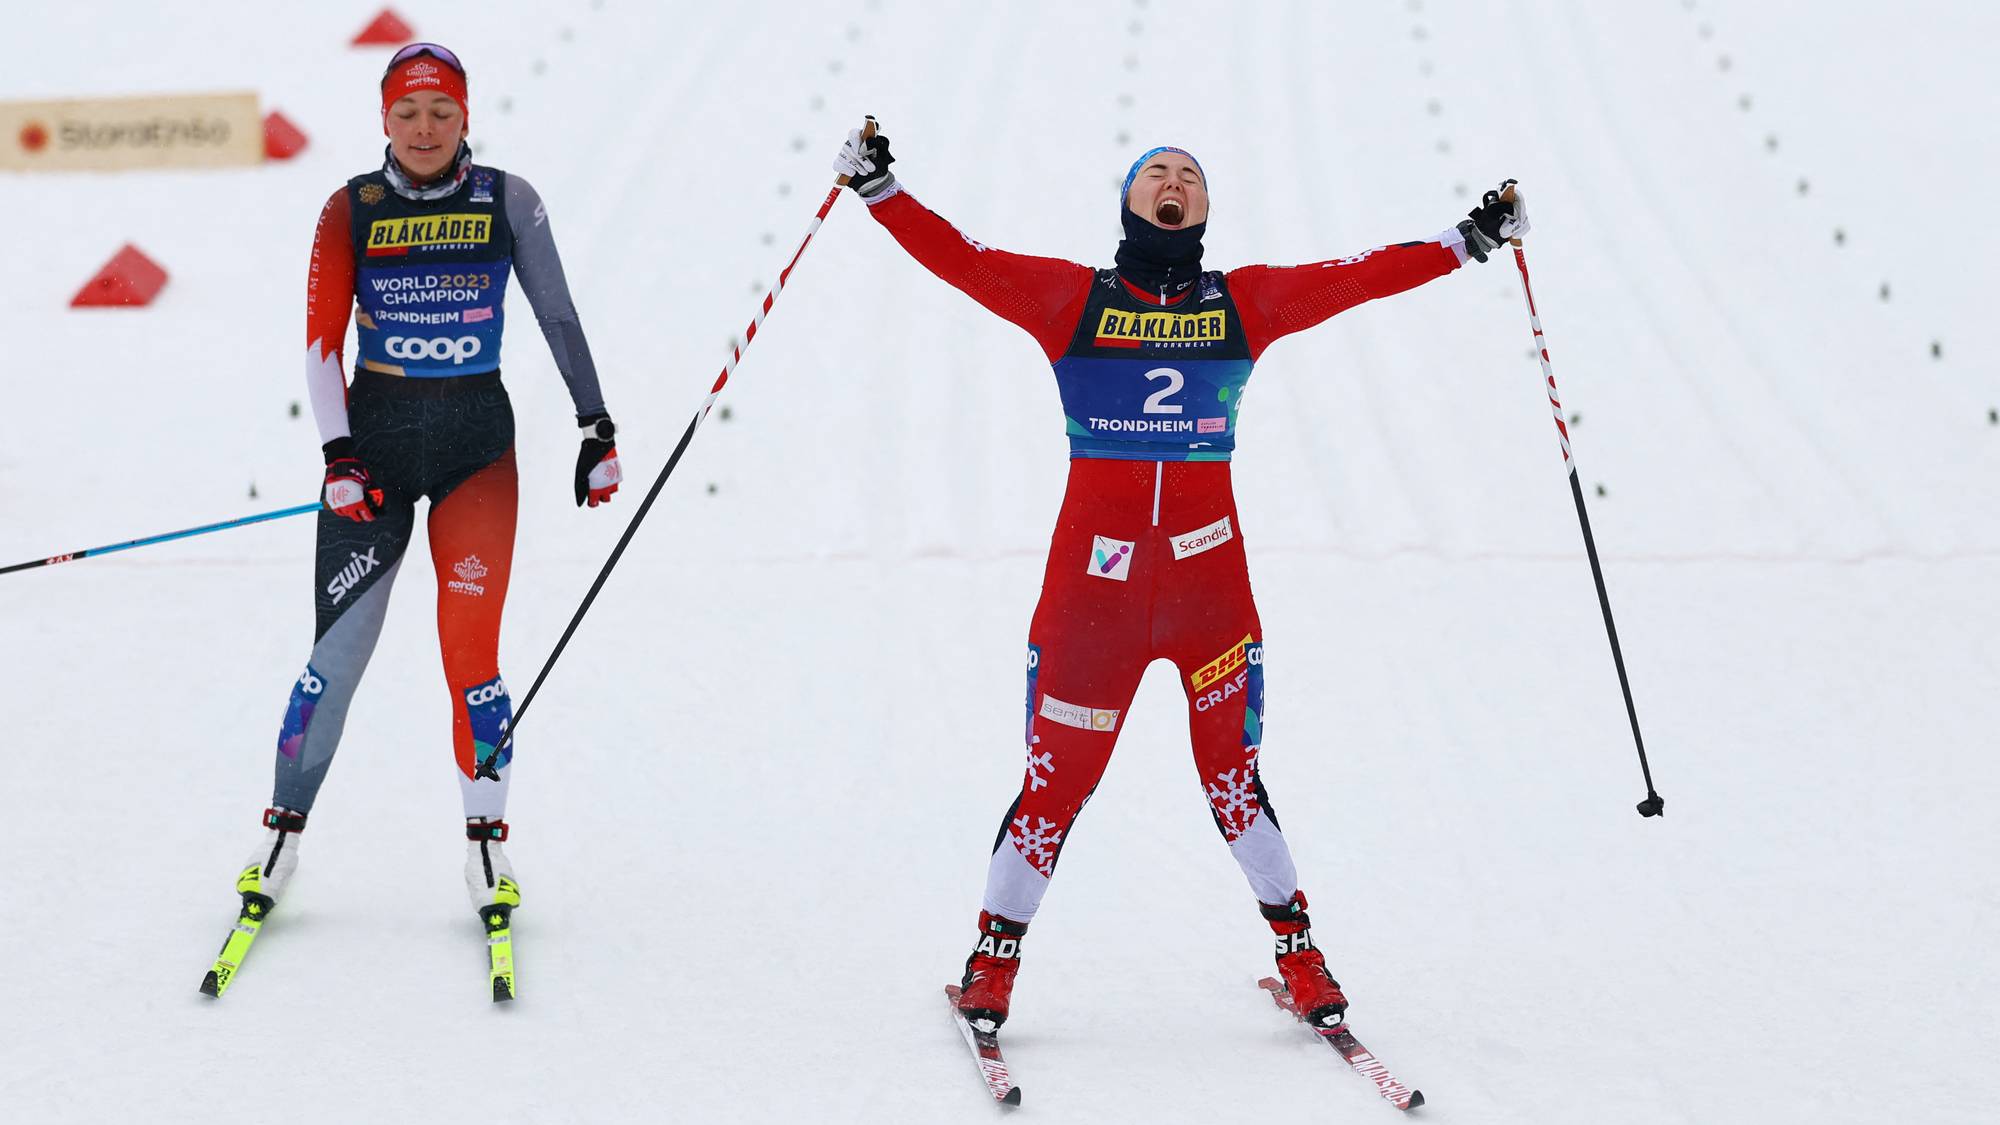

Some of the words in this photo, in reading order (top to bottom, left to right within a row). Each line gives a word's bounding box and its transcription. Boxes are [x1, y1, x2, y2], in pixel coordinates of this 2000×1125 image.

[373, 216, 487, 246] BLÅKLÄDER
[422, 243, 475, 251] WORKWEAR
[372, 275, 438, 291] WORLD
[440, 273, 490, 289] 2023
[383, 289, 479, 305] CHAMPION
[1103, 314, 1221, 338] BLÅKLÄDER
[385, 335, 481, 365] coop
[1143, 367, 1184, 414] 2
[1089, 417, 1193, 432] TRONDHEIM
[1179, 526, 1228, 552] Scandic
[1199, 644, 1247, 686] DHL
[466, 680, 508, 705] coo
[1275, 929, 1312, 954] SH
